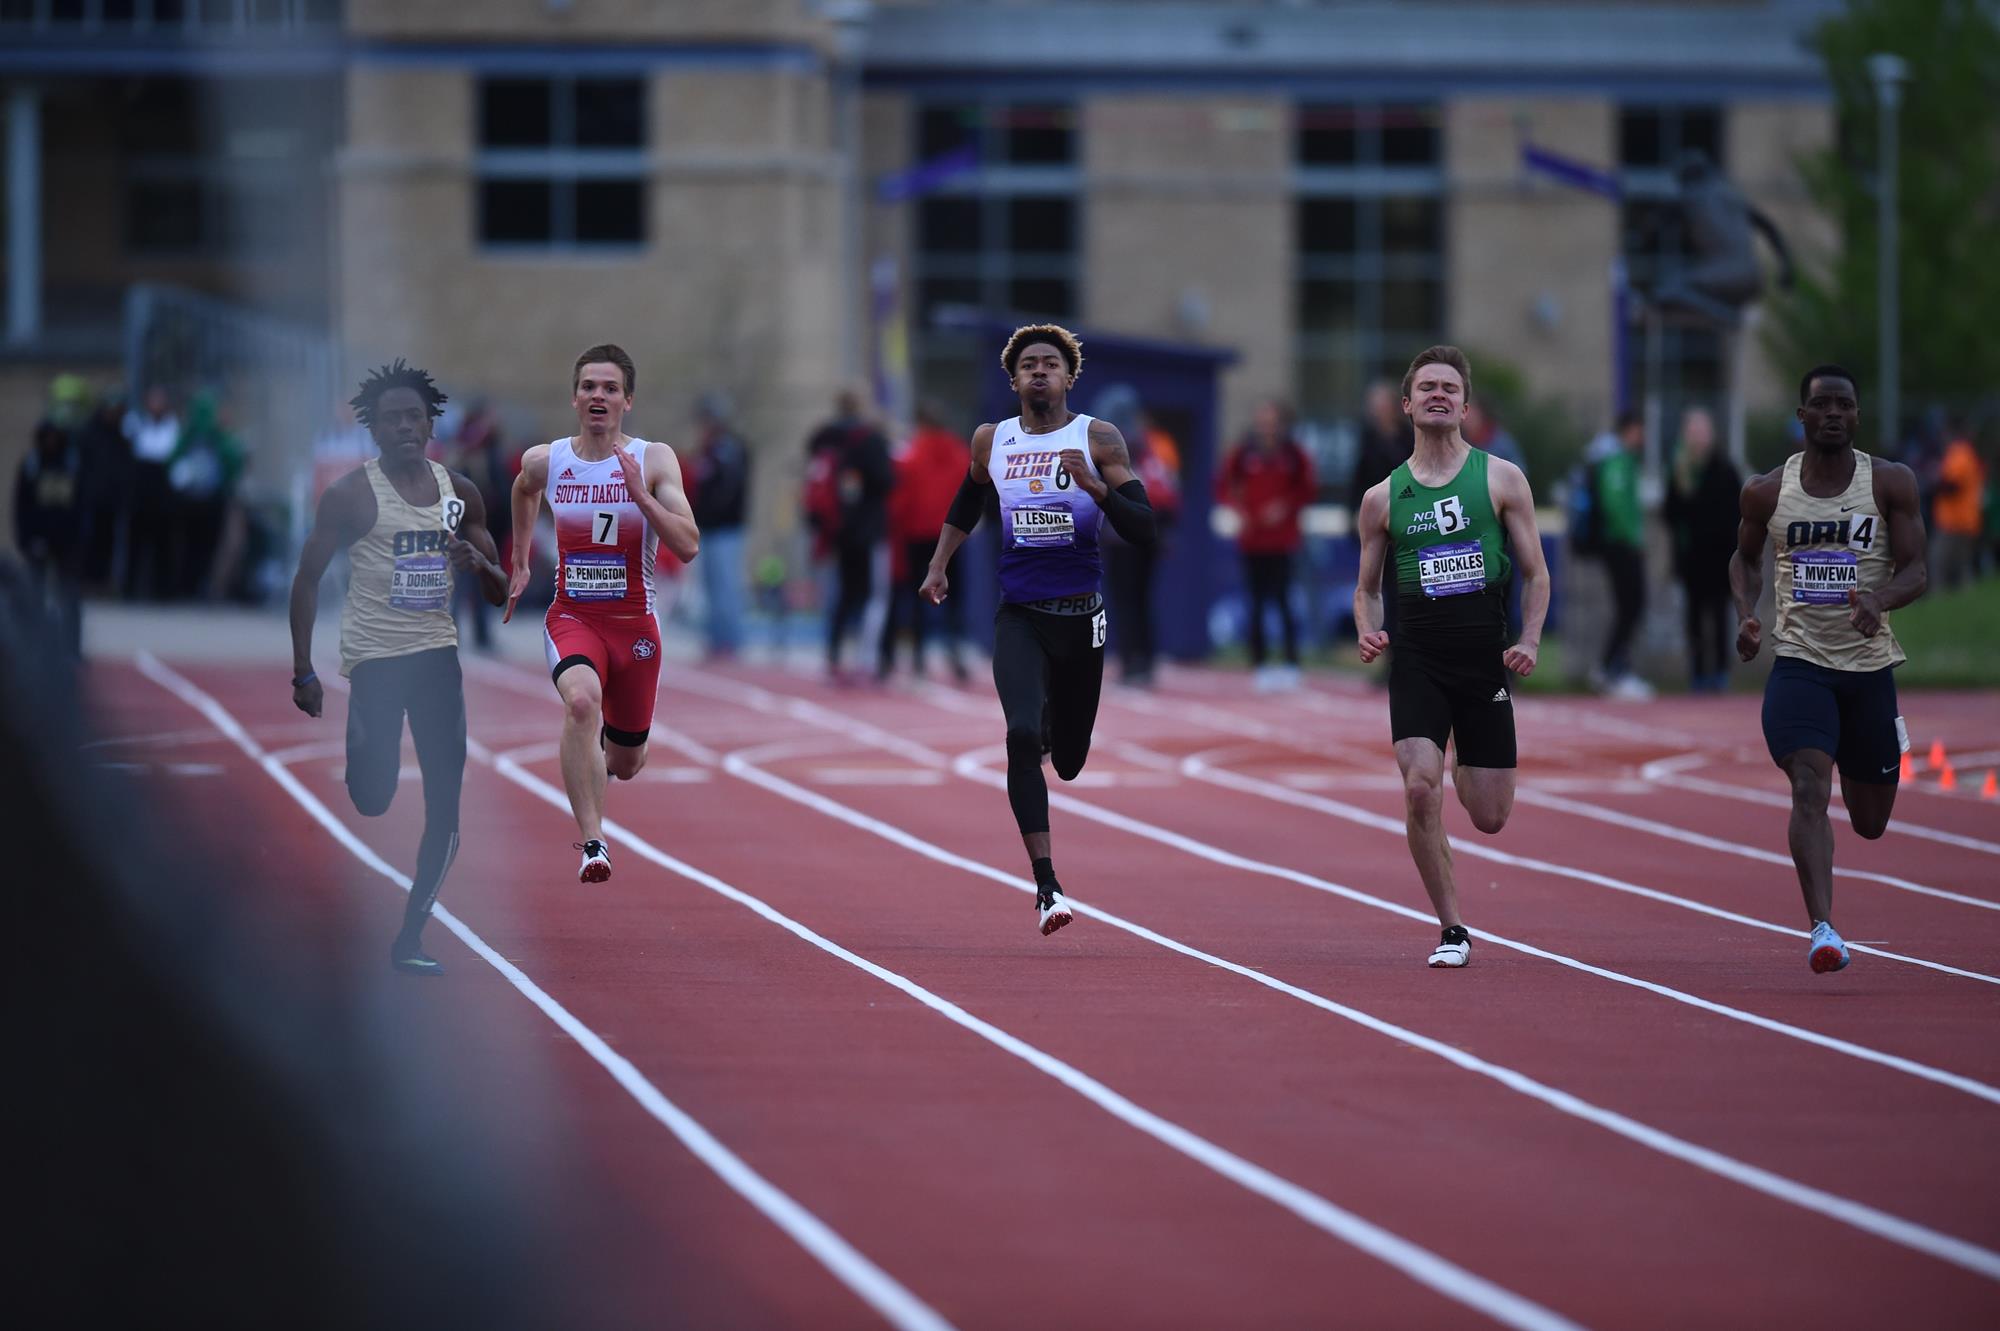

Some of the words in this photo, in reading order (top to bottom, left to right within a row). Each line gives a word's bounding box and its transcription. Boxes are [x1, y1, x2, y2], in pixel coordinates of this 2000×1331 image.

[1006, 451, 1060, 466] WESTER
[1004, 465, 1053, 480] ILLINO
[1056, 461, 1071, 490] 6
[555, 484, 590, 503] SOUTH
[447, 500, 462, 532] 8
[1015, 512, 1023, 525] I.
[1026, 512, 1069, 525] LESURE
[1440, 500, 1458, 532] 5
[599, 513, 613, 543] 7
[1407, 517, 1471, 535] DAKA
[1853, 517, 1873, 549] 4
[566, 567, 574, 579] C.
[576, 567, 625, 580] PENINGTON
[1420, 562, 1431, 577] E.
[1433, 554, 1483, 574] BUCKLES
[1793, 565, 1802, 579] E.
[1805, 566, 1856, 581] MWEWA
[393, 572, 404, 587] B.
[1057, 593, 1097, 613] PRO
[1098, 613, 1105, 644] 6
